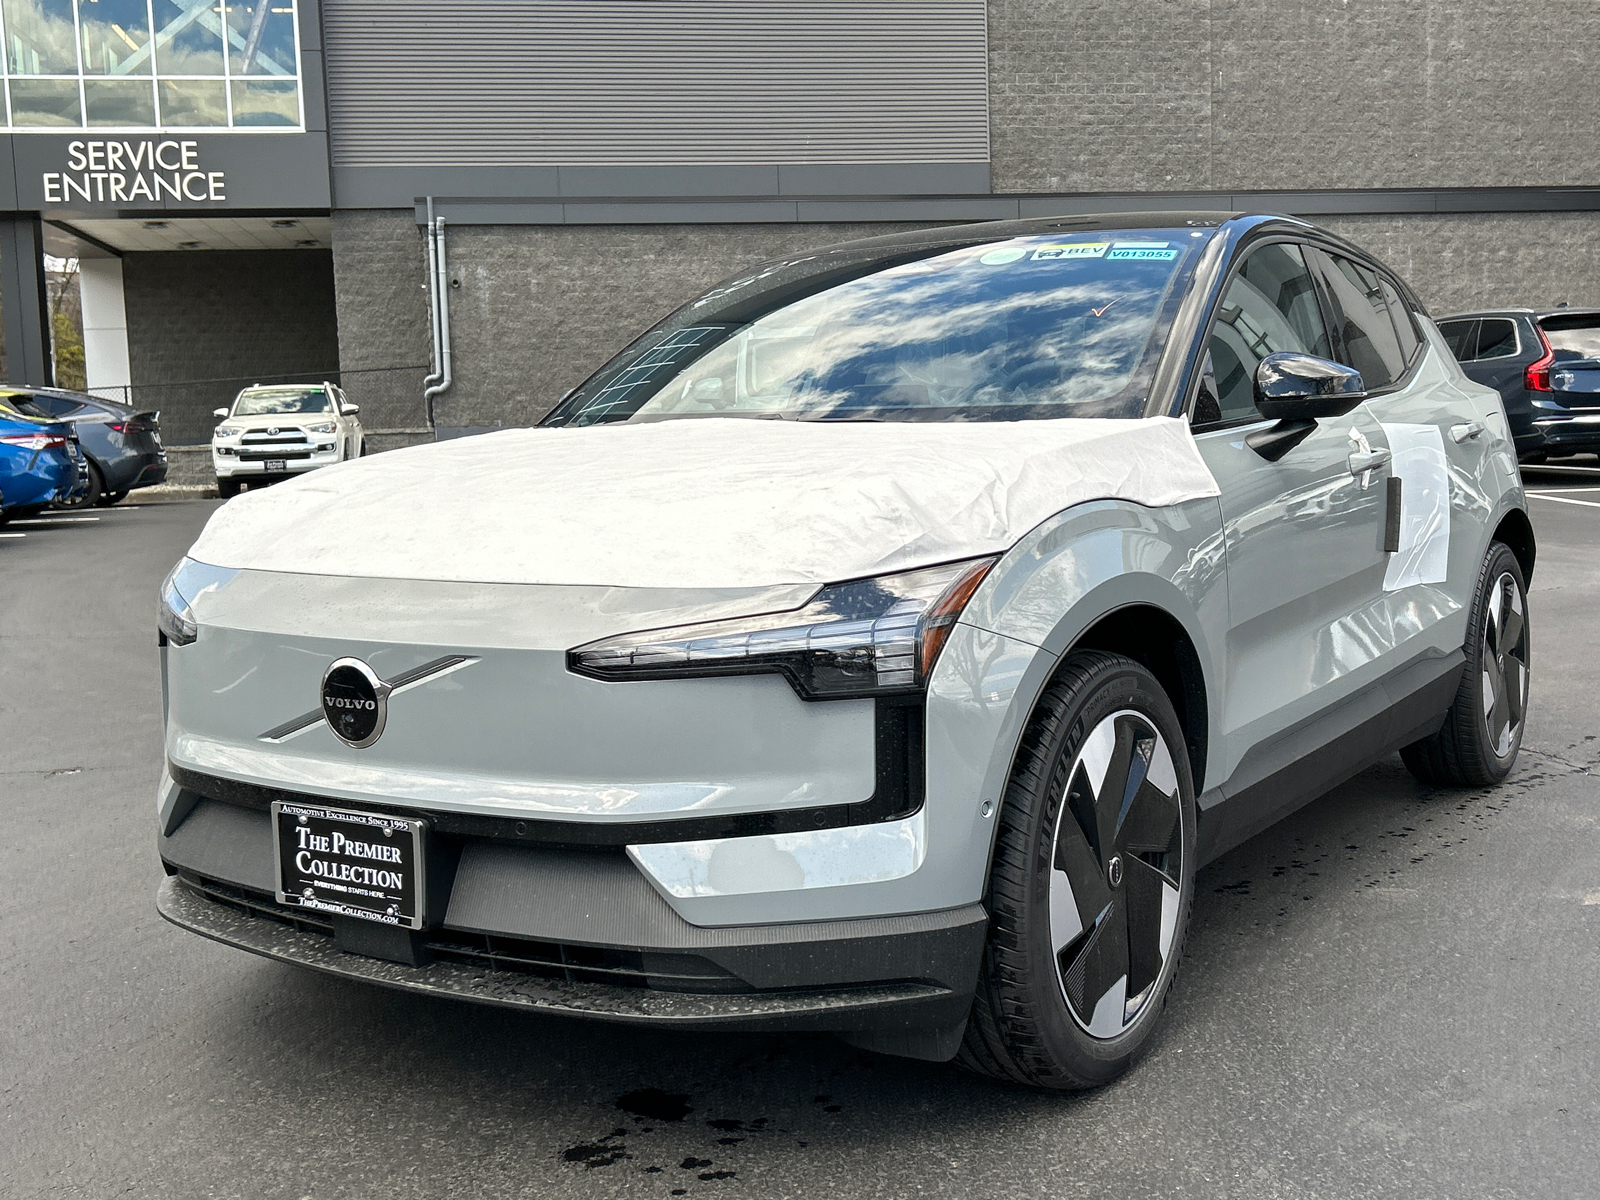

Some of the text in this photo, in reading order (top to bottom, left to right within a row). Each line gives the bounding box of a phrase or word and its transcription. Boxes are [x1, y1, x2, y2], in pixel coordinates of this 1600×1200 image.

[67, 141, 199, 171] SERVICE
[43, 171, 226, 202] ENTRANCE
[1067, 247, 1104, 255] BEV
[325, 696, 376, 711] VOLVO
[1039, 721, 1085, 861] MICHELIN
[390, 820, 409, 831] 1995
[347, 886, 369, 897] STARTS
